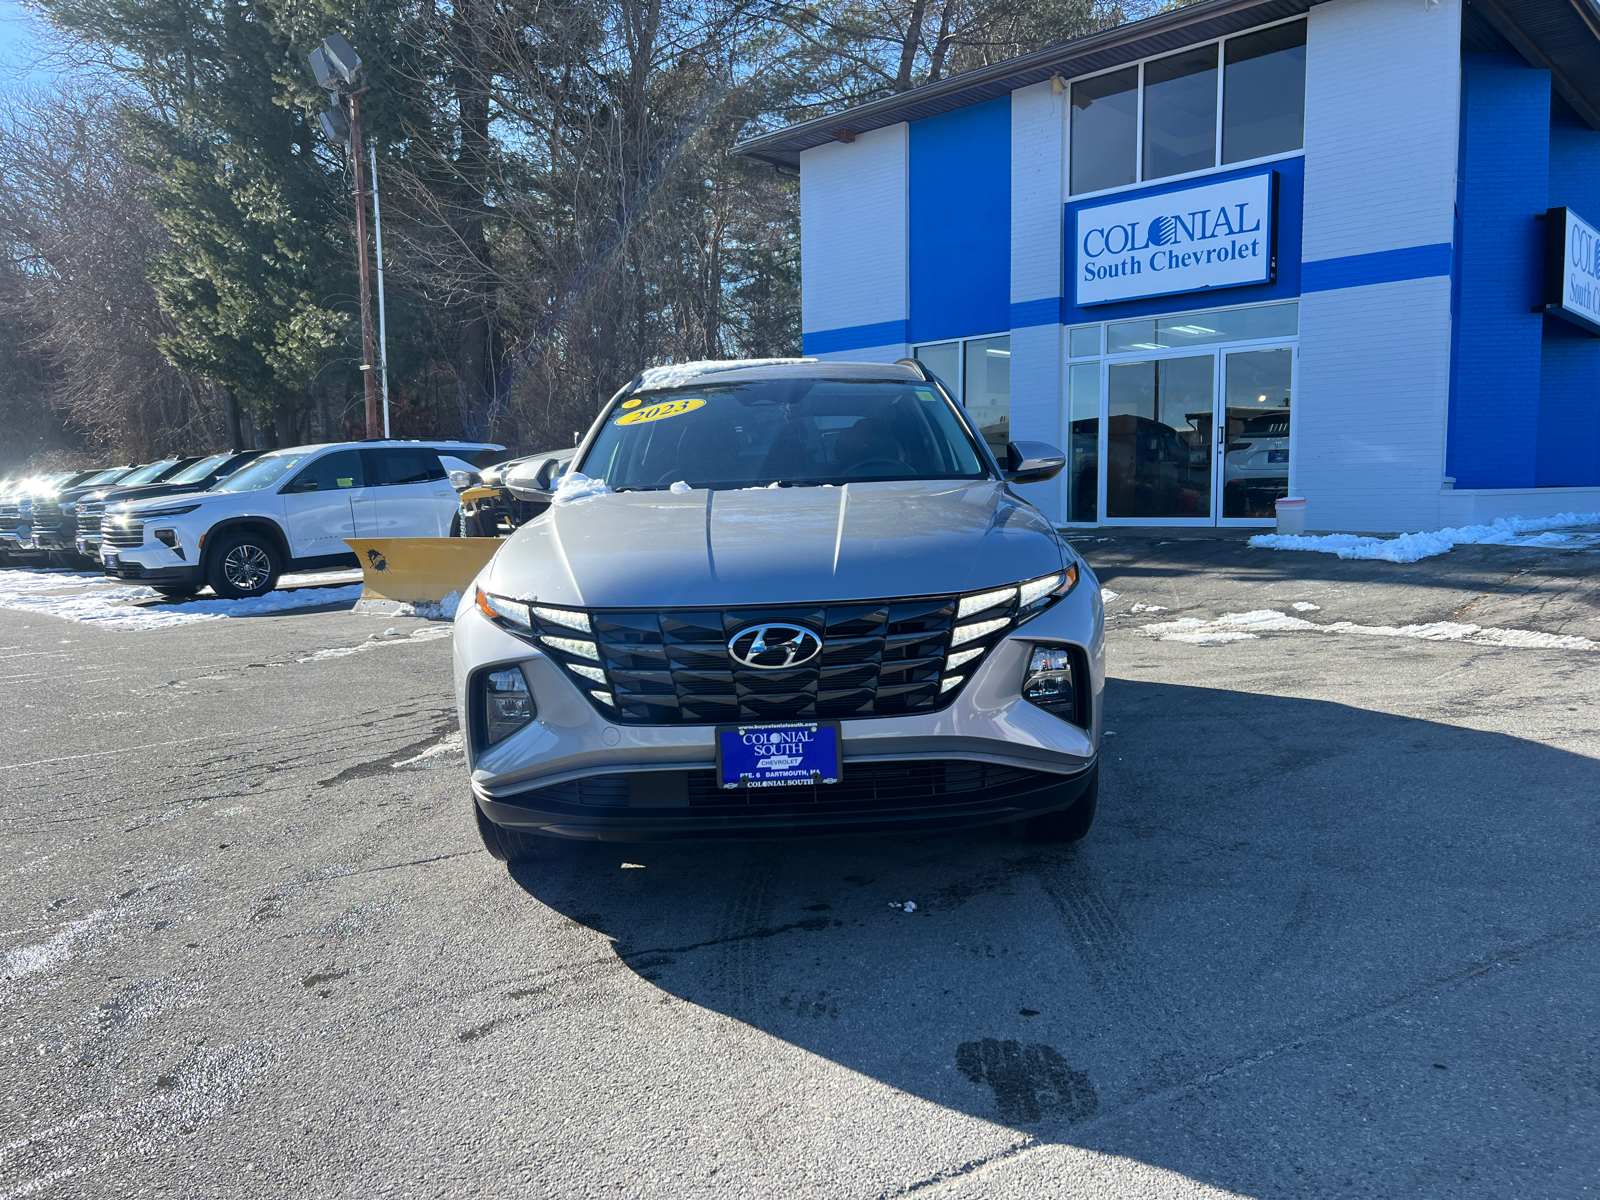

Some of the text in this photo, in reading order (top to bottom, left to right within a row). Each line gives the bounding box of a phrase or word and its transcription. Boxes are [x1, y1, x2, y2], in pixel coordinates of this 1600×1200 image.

[1083, 202, 1261, 258] COLONIAL
[1084, 238, 1260, 282] South Chevrolet
[1570, 273, 1590, 310] South
[631, 401, 689, 422] 2023
[743, 731, 813, 745] COLONIAL
[754, 743, 803, 756] SOUTH
[761, 758, 799, 766] CHEVROLET
[766, 770, 808, 778] DARTMOUTH,
[747, 778, 814, 788] COLONIAL SOUTH
